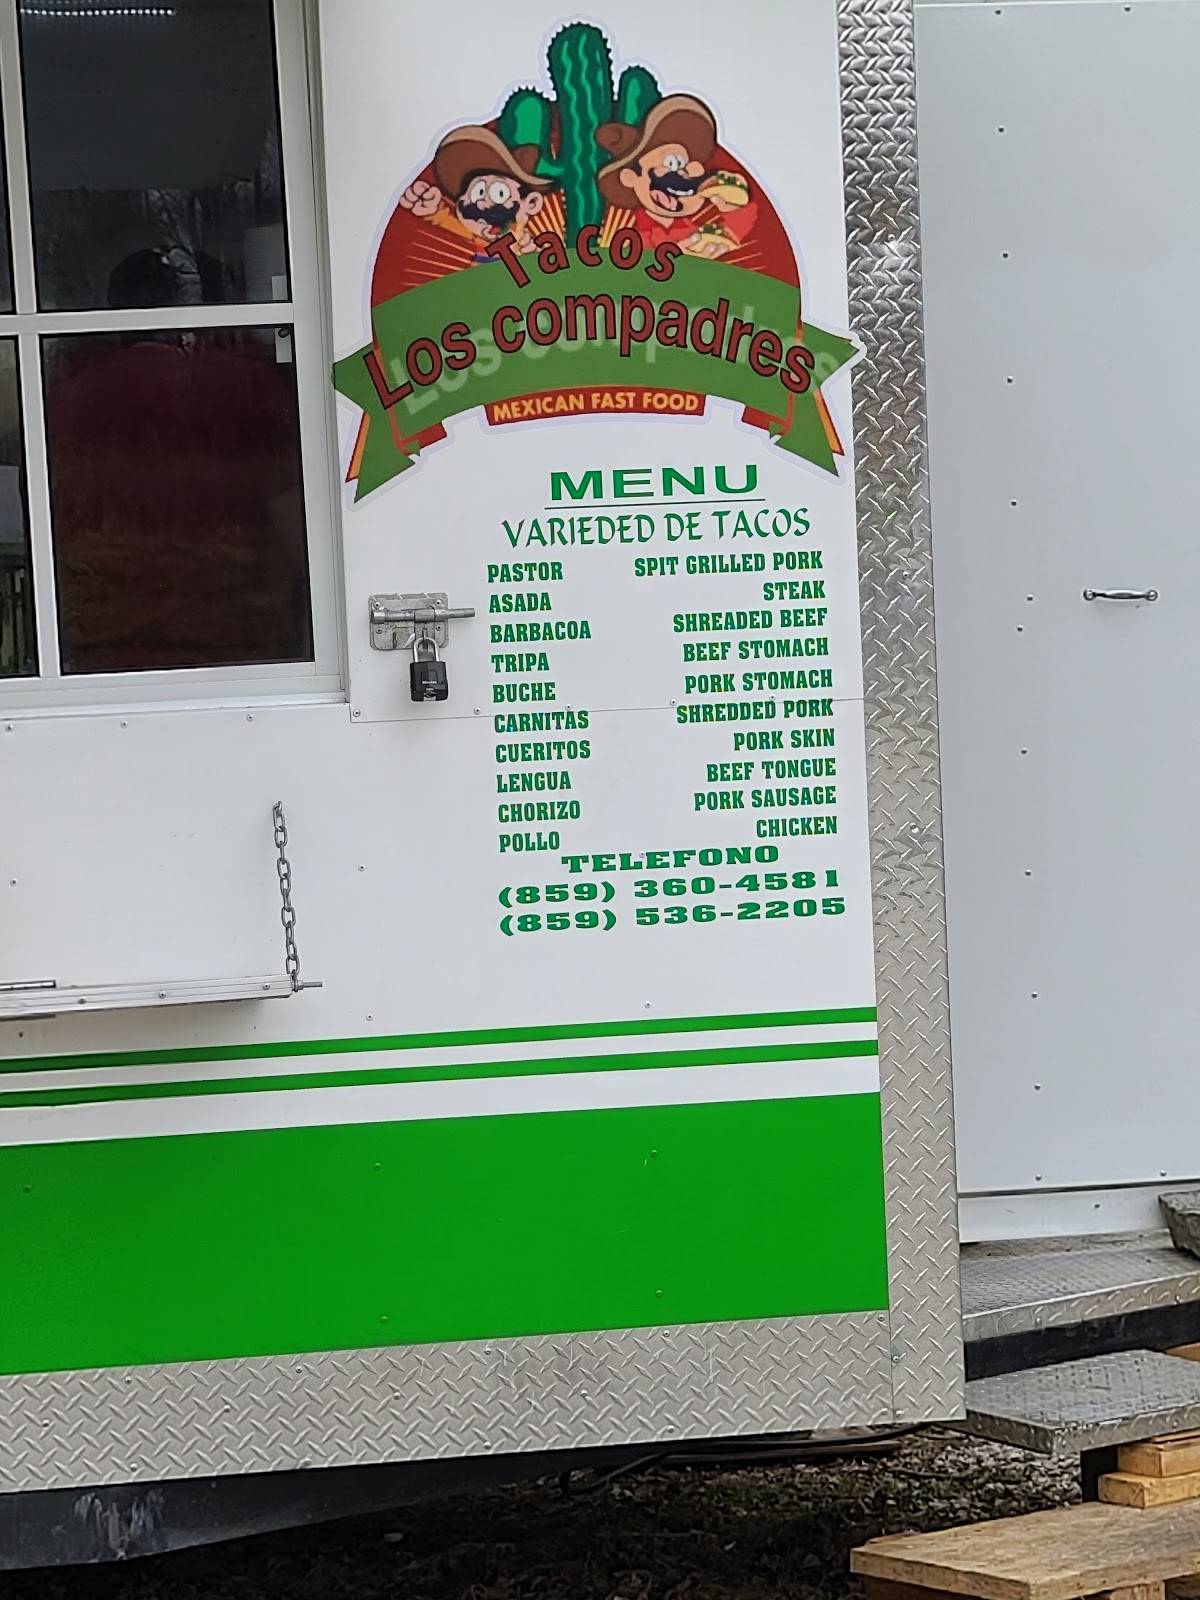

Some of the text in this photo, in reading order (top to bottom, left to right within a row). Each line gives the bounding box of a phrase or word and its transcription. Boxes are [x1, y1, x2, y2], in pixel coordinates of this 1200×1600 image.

[487, 224, 684, 288] Tacos
[364, 293, 816, 409] Los compadres
[494, 393, 698, 422] MEXICAN FAST FOOD
[551, 465, 757, 500] MENU
[502, 508, 810, 548] VARIEDED DE TACOS
[488, 562, 563, 583] PASTOR
[635, 551, 822, 577] SPIT GRILLED PORK
[489, 592, 551, 613] ASADA
[763, 581, 825, 601] STEAK
[491, 621, 591, 643] BARBACOA
[673, 608, 827, 632] SHREADED BEEF
[684, 638, 828, 662] BEEF STOMACH
[491, 653, 549, 673] TRIPA
[493, 682, 555, 703] BUCHE
[685, 669, 832, 694] PORK STOMACH
[494, 710, 588, 733] CARNITAS
[677, 698, 832, 723] SHREDDED PORK
[496, 740, 590, 762] CUERITOS
[734, 729, 834, 751] PORK SKIN
[497, 771, 571, 793] LENGUA
[707, 758, 836, 782] BEEF TONGUE
[695, 786, 836, 811] PORK SAUSAGE
[498, 800, 580, 823] CHORIZO
[757, 816, 837, 838] CHICKEN
[499, 832, 559, 852] POLLO
[561, 845, 779, 873] TELEFONO
[498, 870, 839, 909] (859) 360-4581
[499, 897, 846, 936] (859) 536-2205
